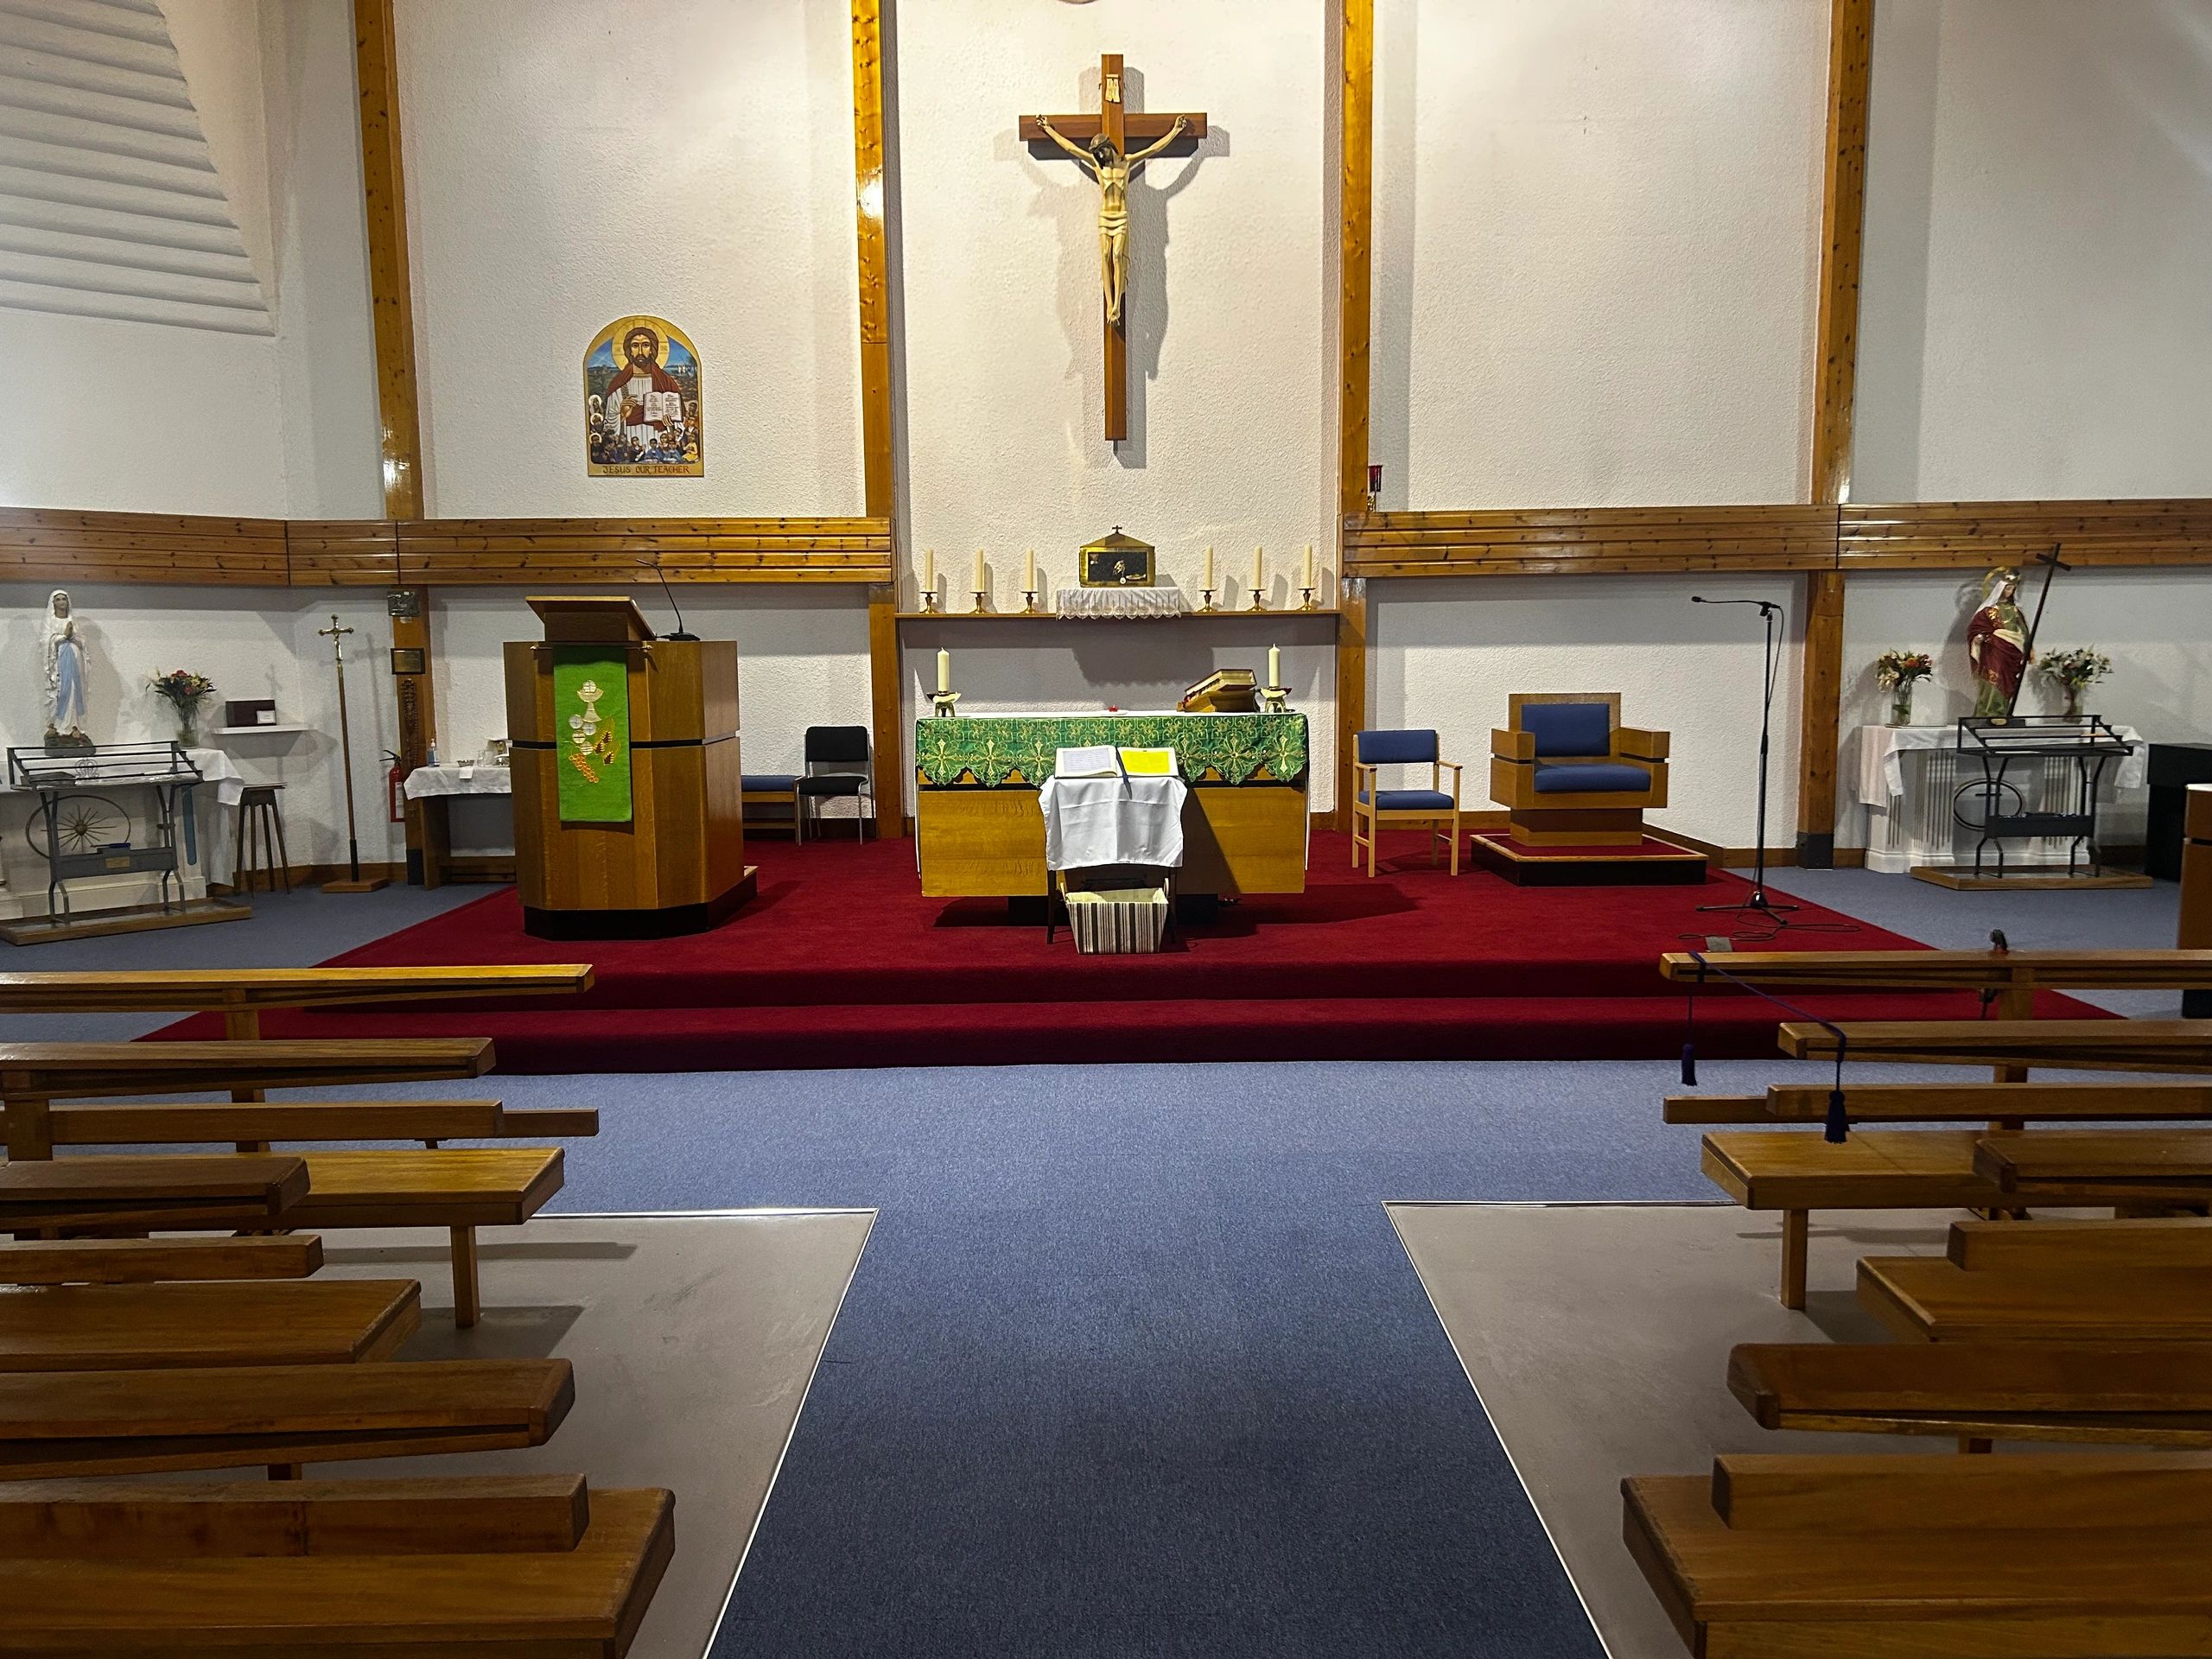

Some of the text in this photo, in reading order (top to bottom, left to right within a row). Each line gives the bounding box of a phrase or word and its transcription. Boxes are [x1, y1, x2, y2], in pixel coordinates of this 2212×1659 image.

[602, 465, 690, 474] JESUS OUR TEACHER
